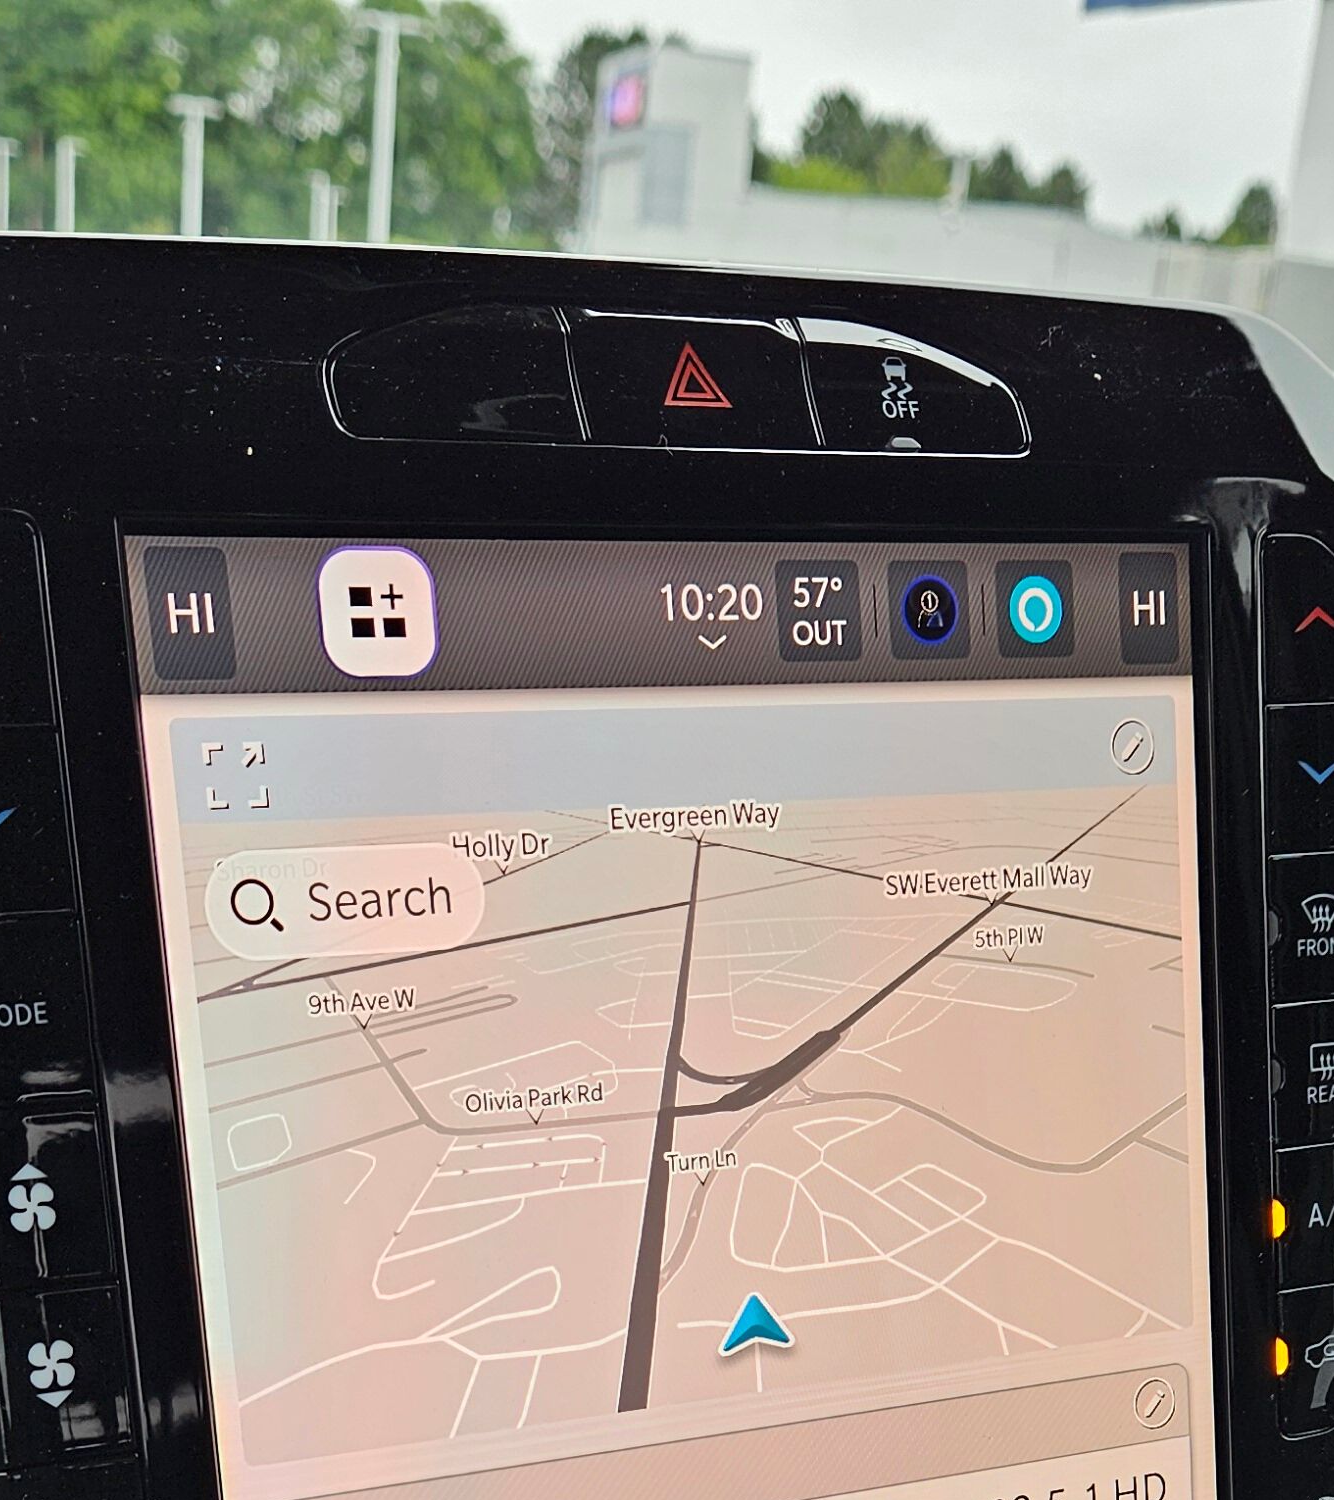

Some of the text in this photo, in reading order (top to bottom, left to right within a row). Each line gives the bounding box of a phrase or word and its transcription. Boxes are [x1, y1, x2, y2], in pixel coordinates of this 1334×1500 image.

[882, 401, 919, 420] OFF
[661, 583, 763, 621] 10:20
[793, 577, 843, 608] 57°
[167, 592, 215, 634] HI
[1133, 590, 1166, 627] HI
[792, 620, 847, 646] OUT
[611, 802, 780, 833] Evergreen Way
[452, 832, 550, 862] Holly Dr
[885, 864, 1092, 896] SW Everett Mall Way
[308, 876, 452, 922] Search
[974, 929, 1004, 949] 5th
[1027, 925, 1044, 944] W
[308, 988, 416, 1016] 9th Ave W
[465, 1083, 603, 1114] Olivia Park Rd
[668, 1150, 737, 1174] Turn Ln
